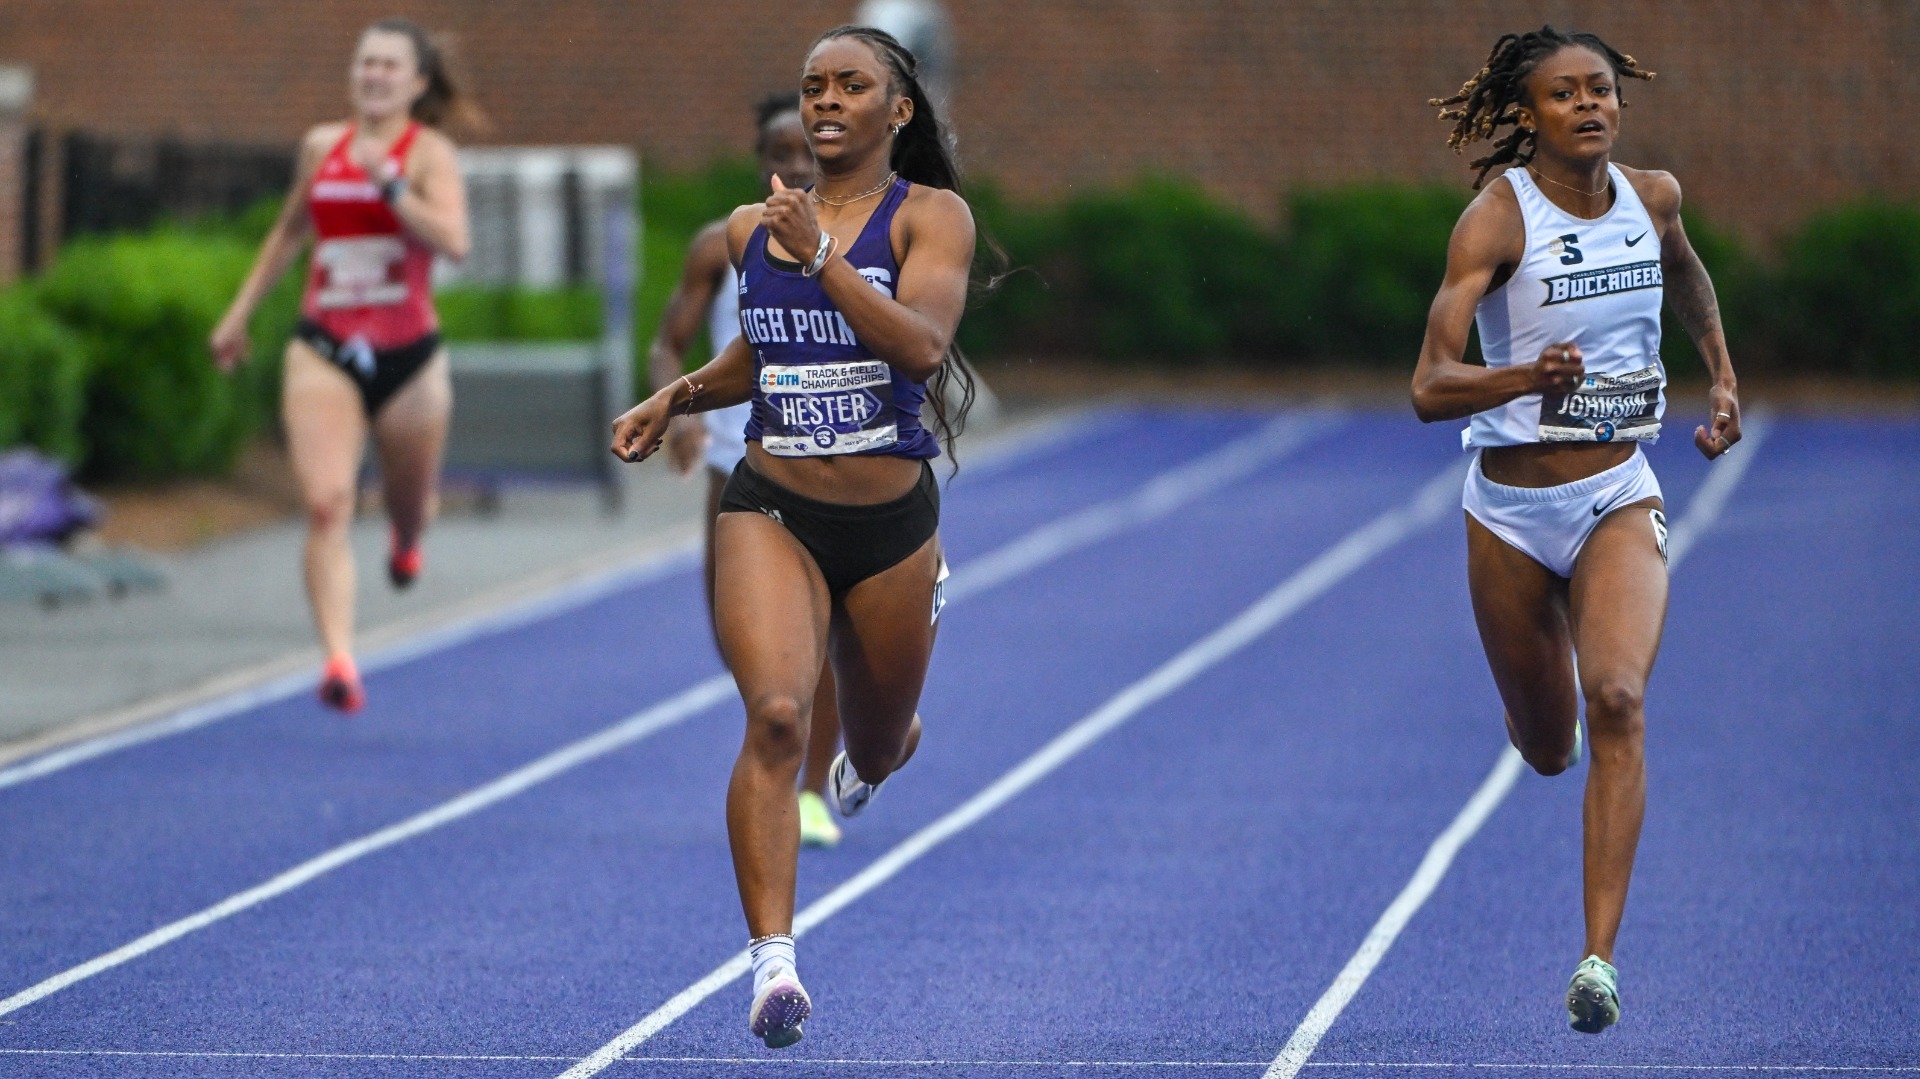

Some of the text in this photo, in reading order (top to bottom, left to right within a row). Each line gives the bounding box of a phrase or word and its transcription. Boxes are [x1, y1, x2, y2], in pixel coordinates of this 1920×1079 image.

[1558, 233, 1584, 266] S
[790, 308, 857, 346] POIN
[801, 373, 885, 389] CHAMPIONSHIPS
[805, 365, 878, 379] TRACK & FIELD
[781, 394, 867, 426] HESTER
[1557, 392, 1647, 418] JOHNSON
